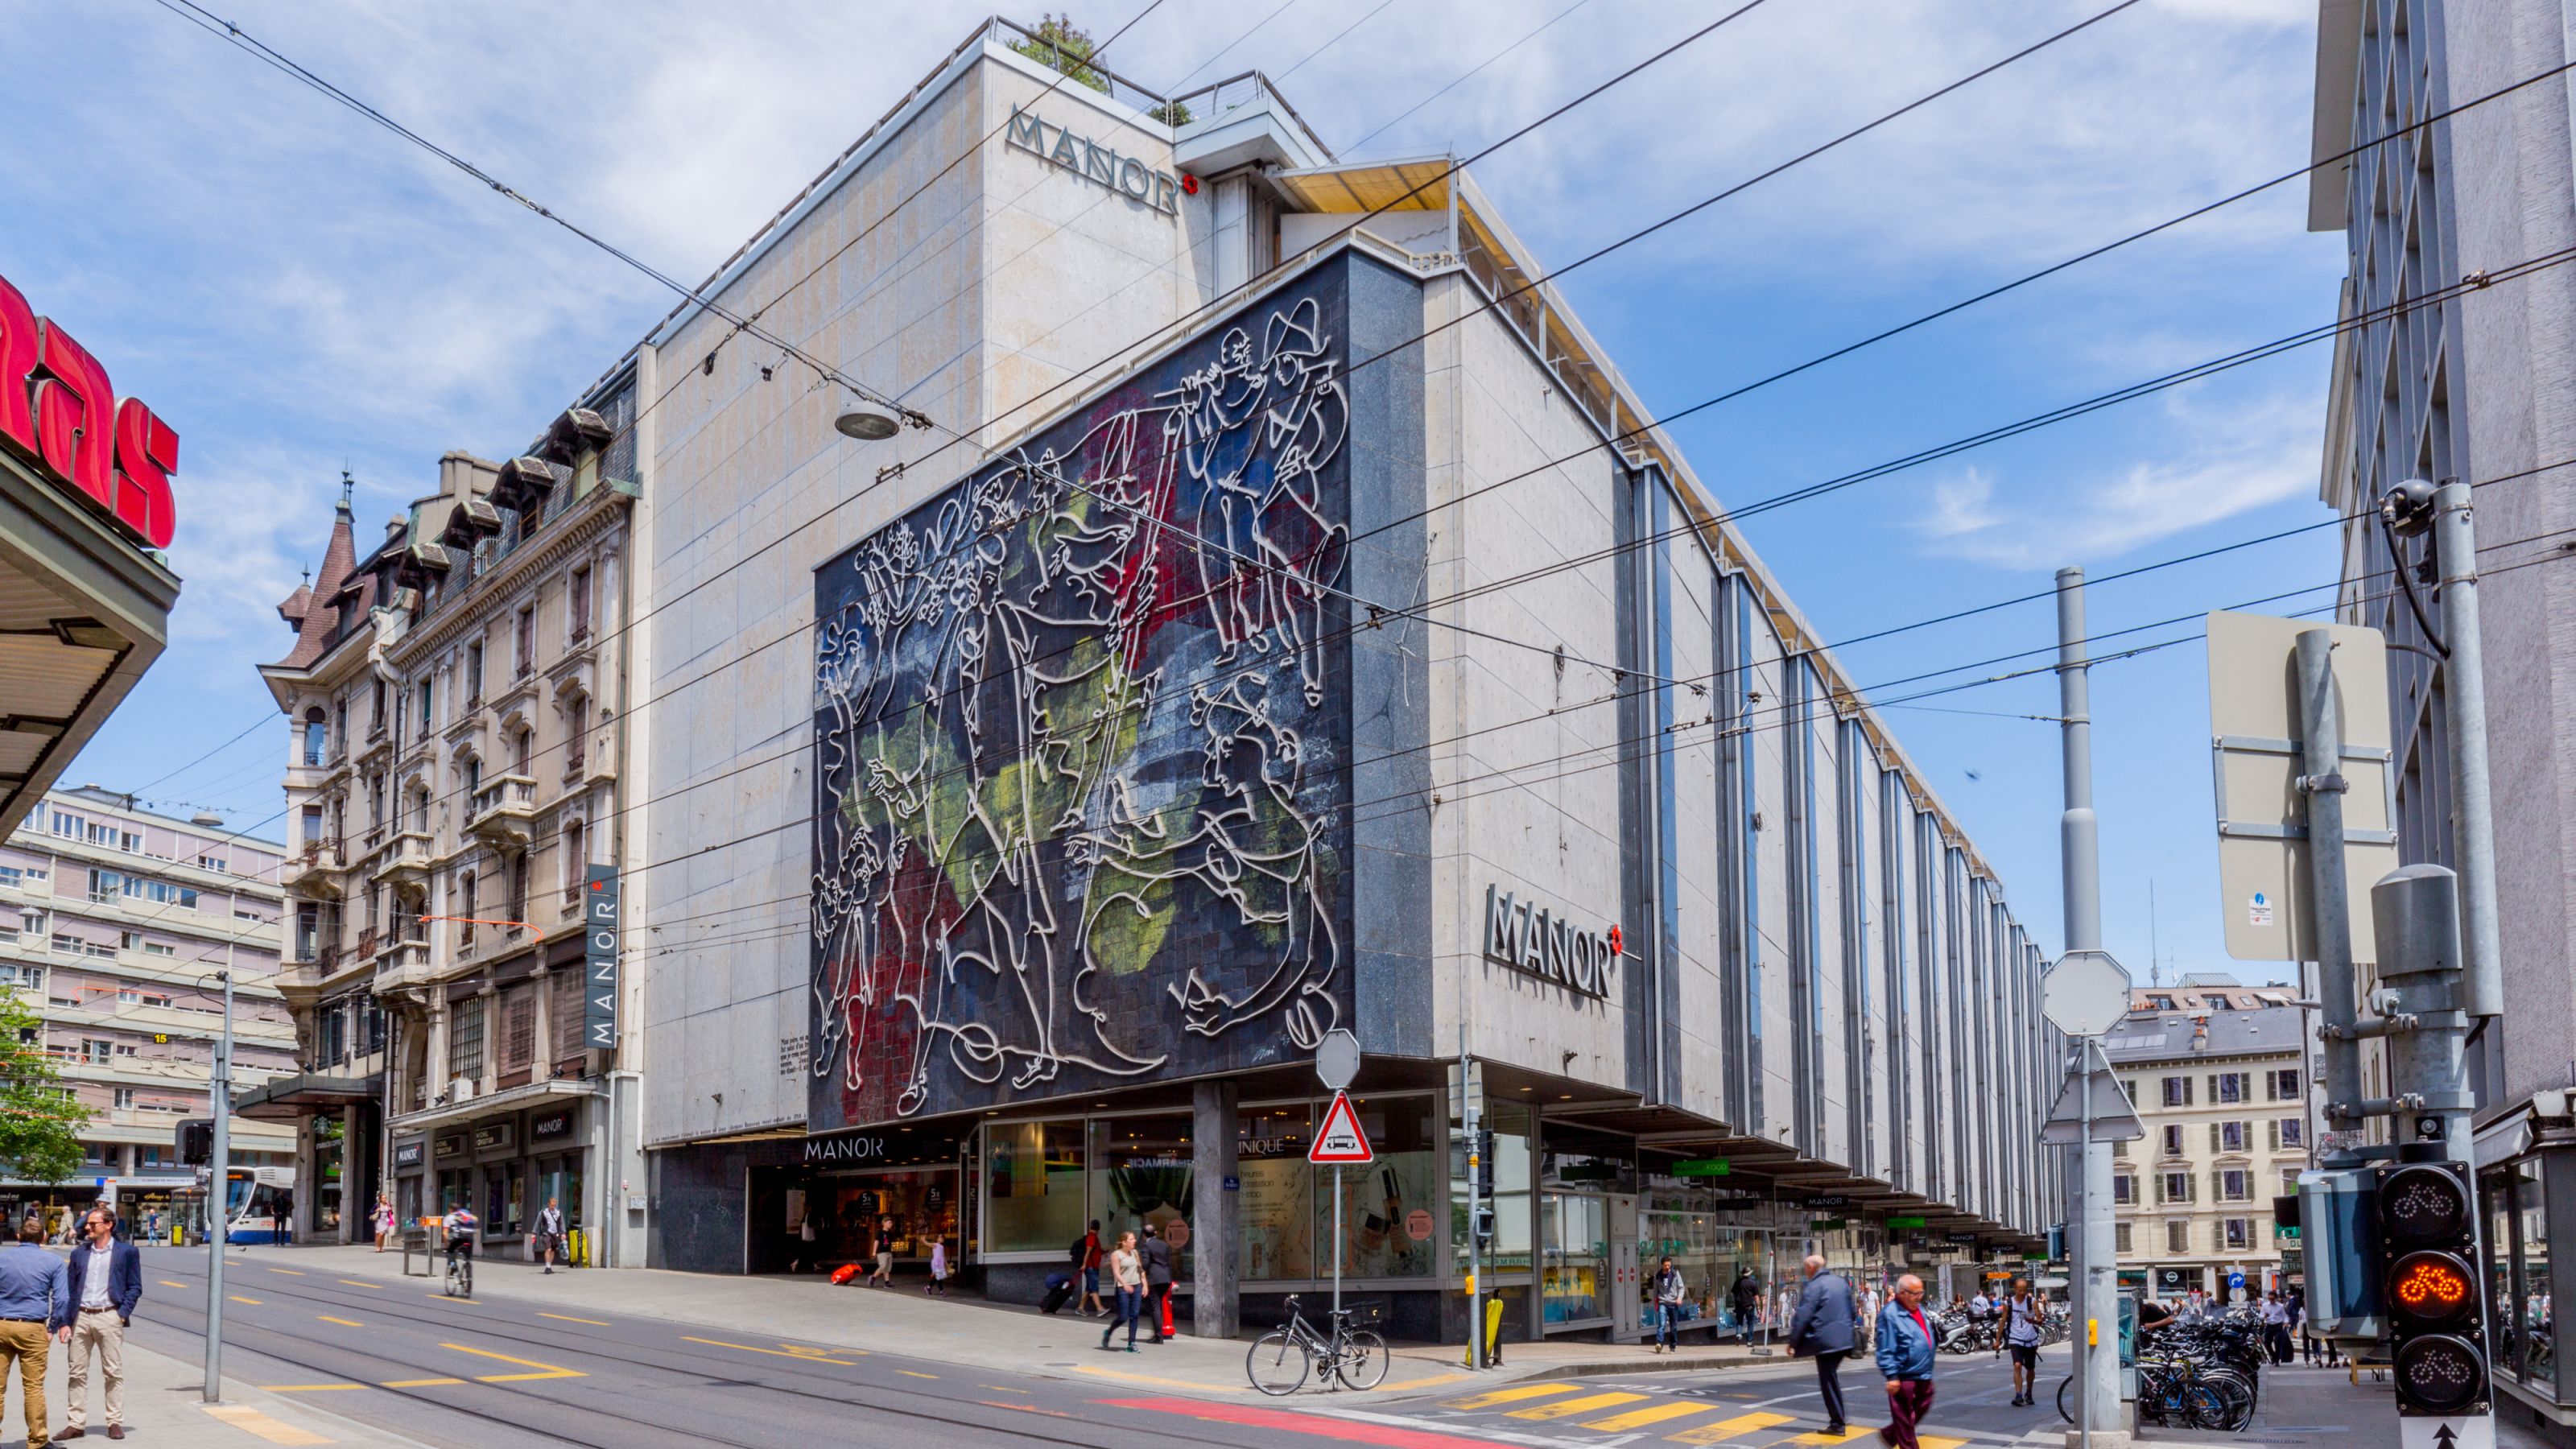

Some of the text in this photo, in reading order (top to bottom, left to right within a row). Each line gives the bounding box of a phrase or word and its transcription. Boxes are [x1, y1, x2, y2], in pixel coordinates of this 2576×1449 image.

[1005, 101, 1179, 216] MANOR
[1484, 883, 1610, 998] MANOR
[593, 902, 615, 1043] MANOR
[155, 1034, 167, 1044] 15
[538, 1118, 562, 1133] MANOR
[398, 1148, 417, 1162] MANOR
[805, 1137, 883, 1160] MANOR
[1808, 1197, 1843, 1205] MANOR
